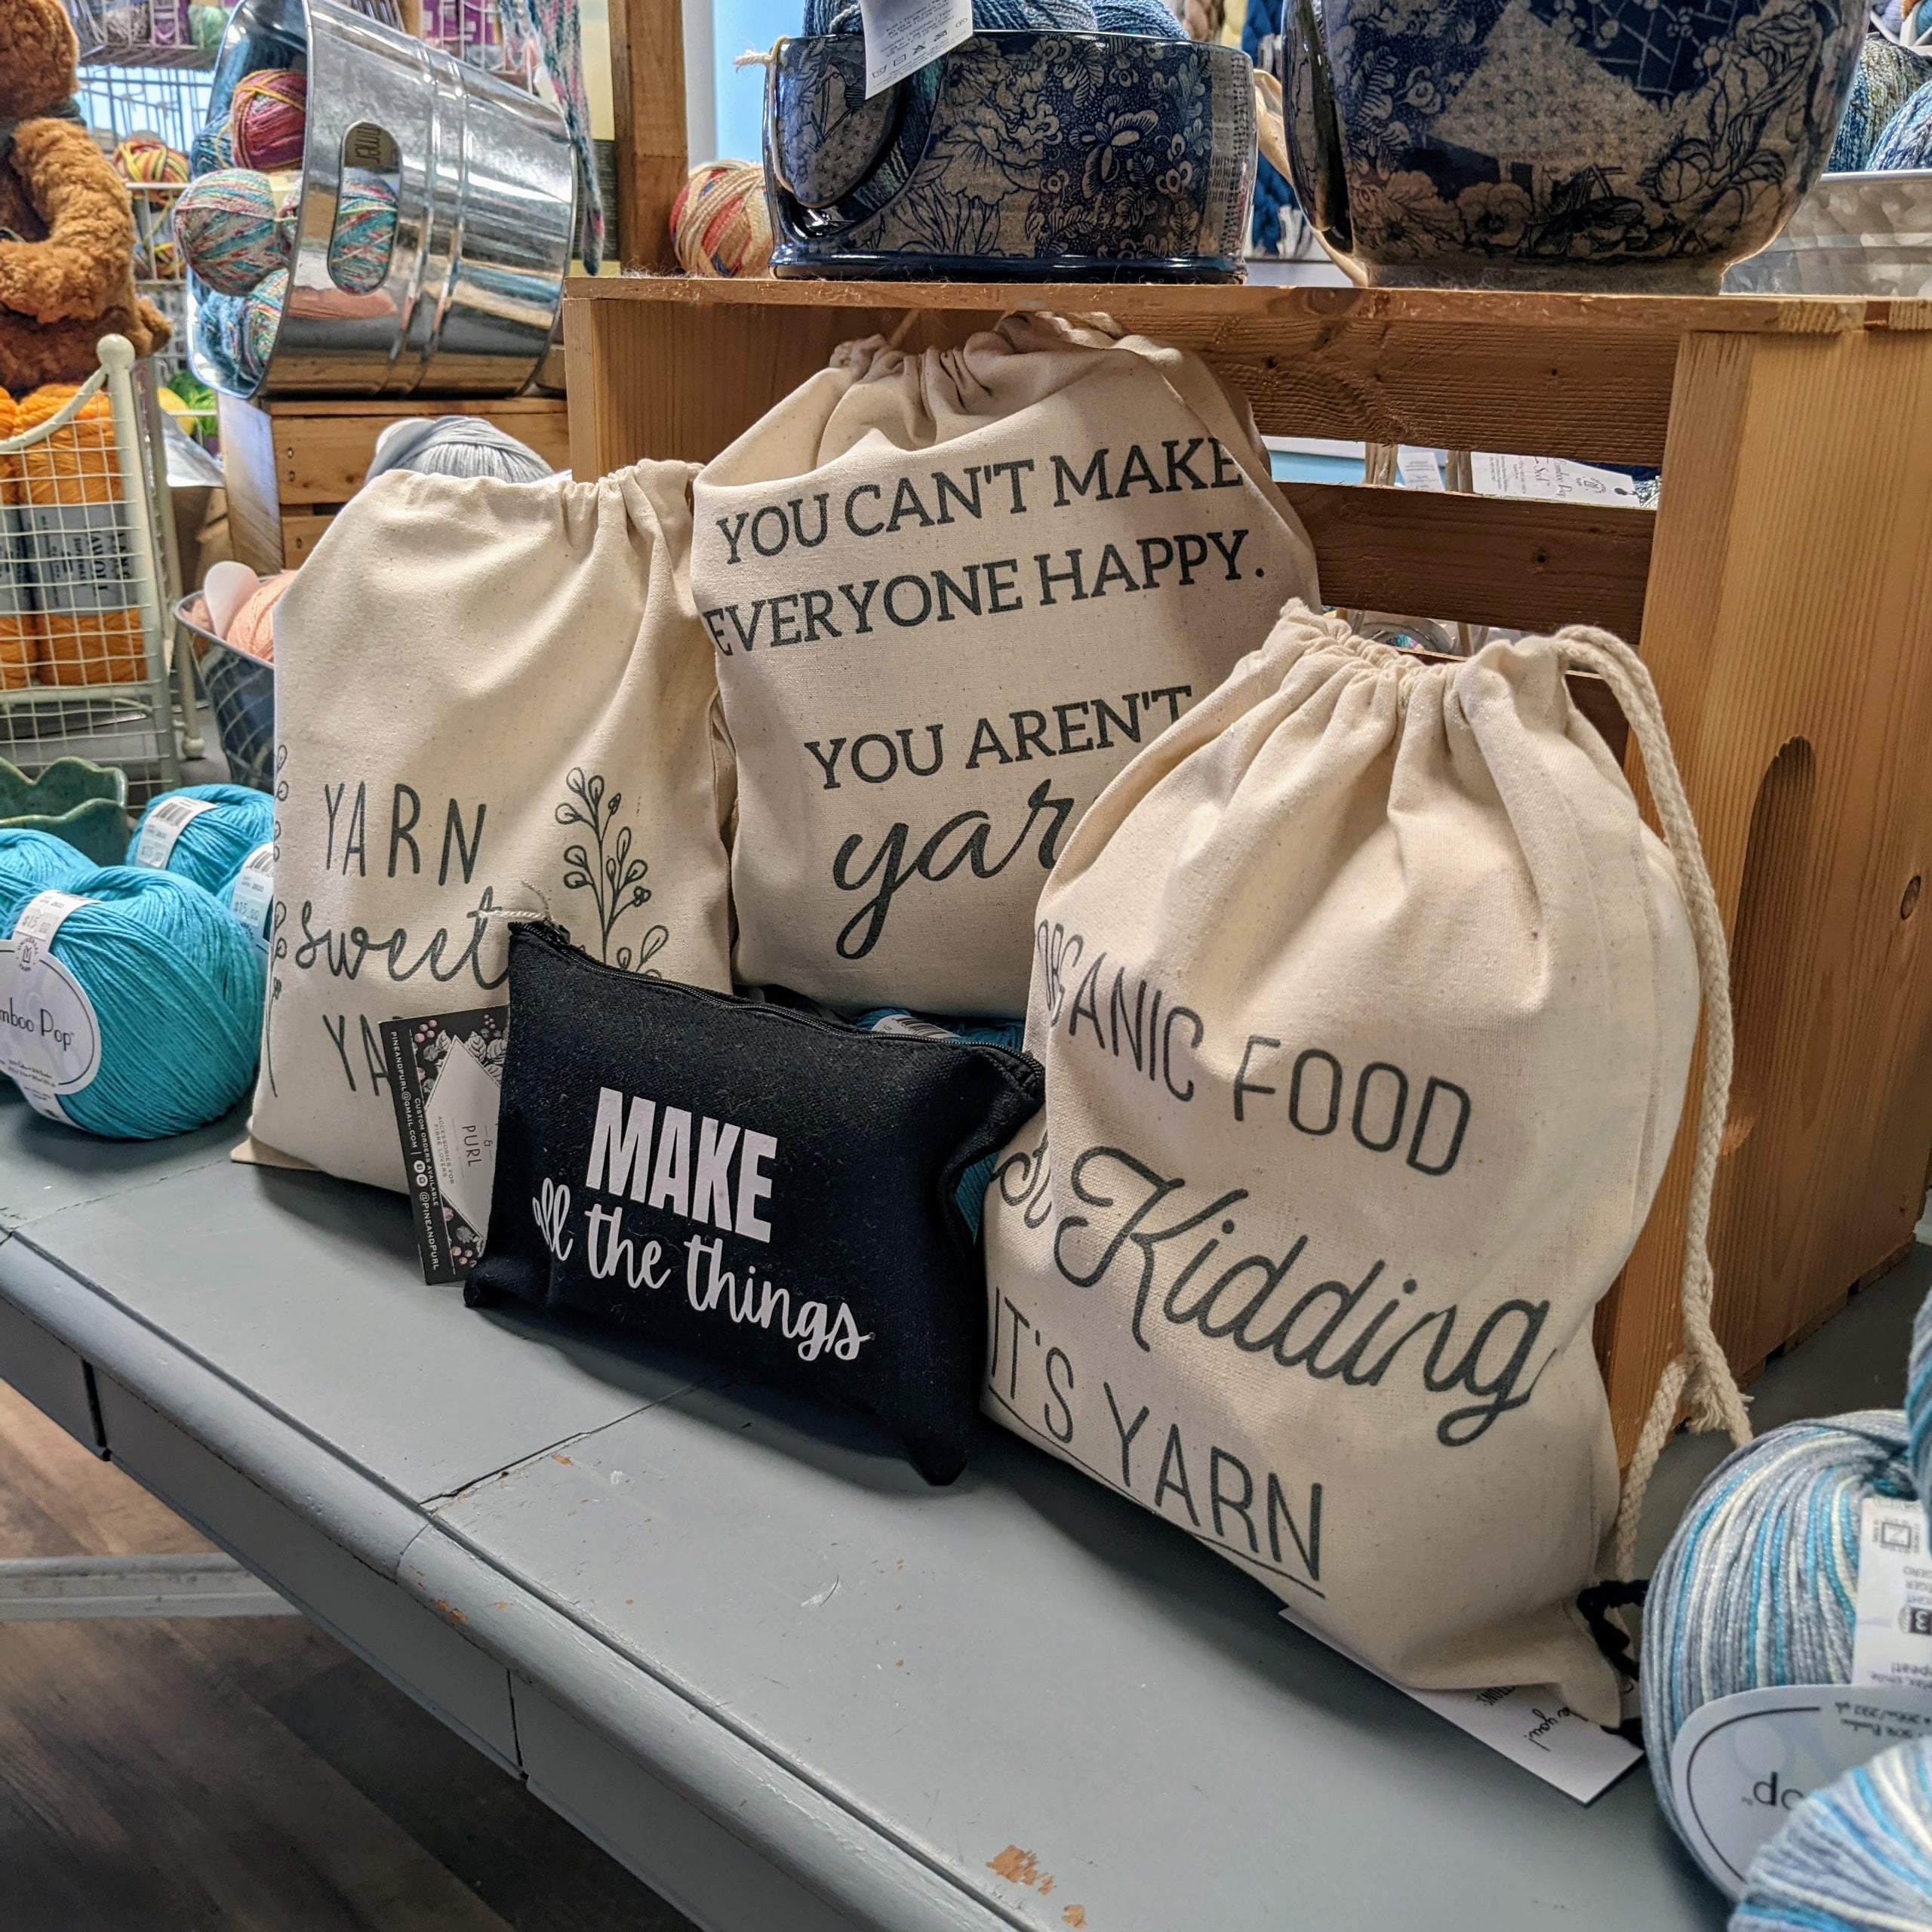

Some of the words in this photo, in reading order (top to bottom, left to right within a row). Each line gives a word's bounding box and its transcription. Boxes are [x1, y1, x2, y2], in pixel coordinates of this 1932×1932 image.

[715, 492, 829, 566] YOU
[844, 458, 1035, 537] CAN'T
[1050, 435, 1246, 507] MAKE
[700, 557, 1023, 657] EVERYONE
[1033, 528, 1266, 606] HAPPY.
[804, 723, 944, 790] YOU
[964, 685, 1192, 770] AREN'T
[324, 780, 487, 886] YARN
[832, 777, 1076, 960] yar
[40, 1008, 72, 1052] Pop
[322, 1014, 392, 1097] YA
[414, 1097, 425, 1133] CUSTOM
[420, 1133, 431, 1163] ORDERS
[426, 1165, 439, 1207] AVAILABLE
[461, 1124, 483, 1168] PURL
[1233, 1035, 1471, 1177] FOOD
[585, 1086, 778, 1243] MAKE
[584, 1203, 672, 1289] the
[684, 1234, 872, 1361] things
[1053, 1145, 1557, 1447] Kidding
[991, 1286, 1074, 1444] IT'S
[1103, 1381, 1323, 1582] YARN
[1915, 1608, 1929, 1631] 3
[1523, 1708, 1558, 1752] you!
[1753, 1771, 1804, 1810] op
